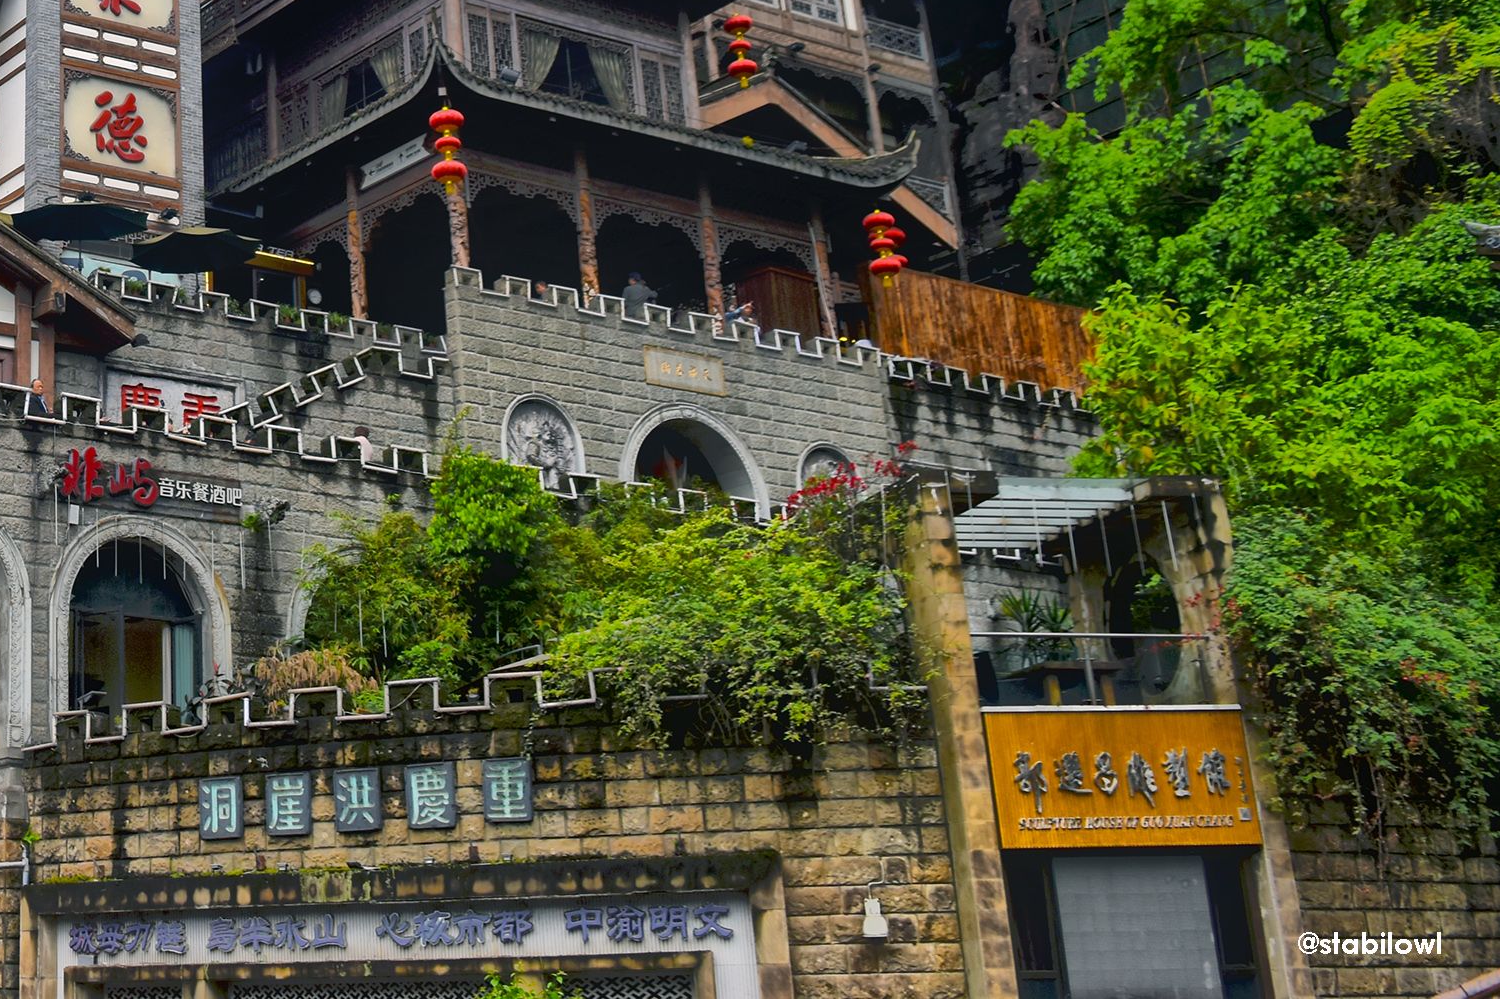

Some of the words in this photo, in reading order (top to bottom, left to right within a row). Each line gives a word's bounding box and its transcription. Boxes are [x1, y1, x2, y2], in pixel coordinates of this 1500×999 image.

[159, 478, 243, 507] 音乐餐酒吧
[1084, 815, 1124, 829] HOUSE
